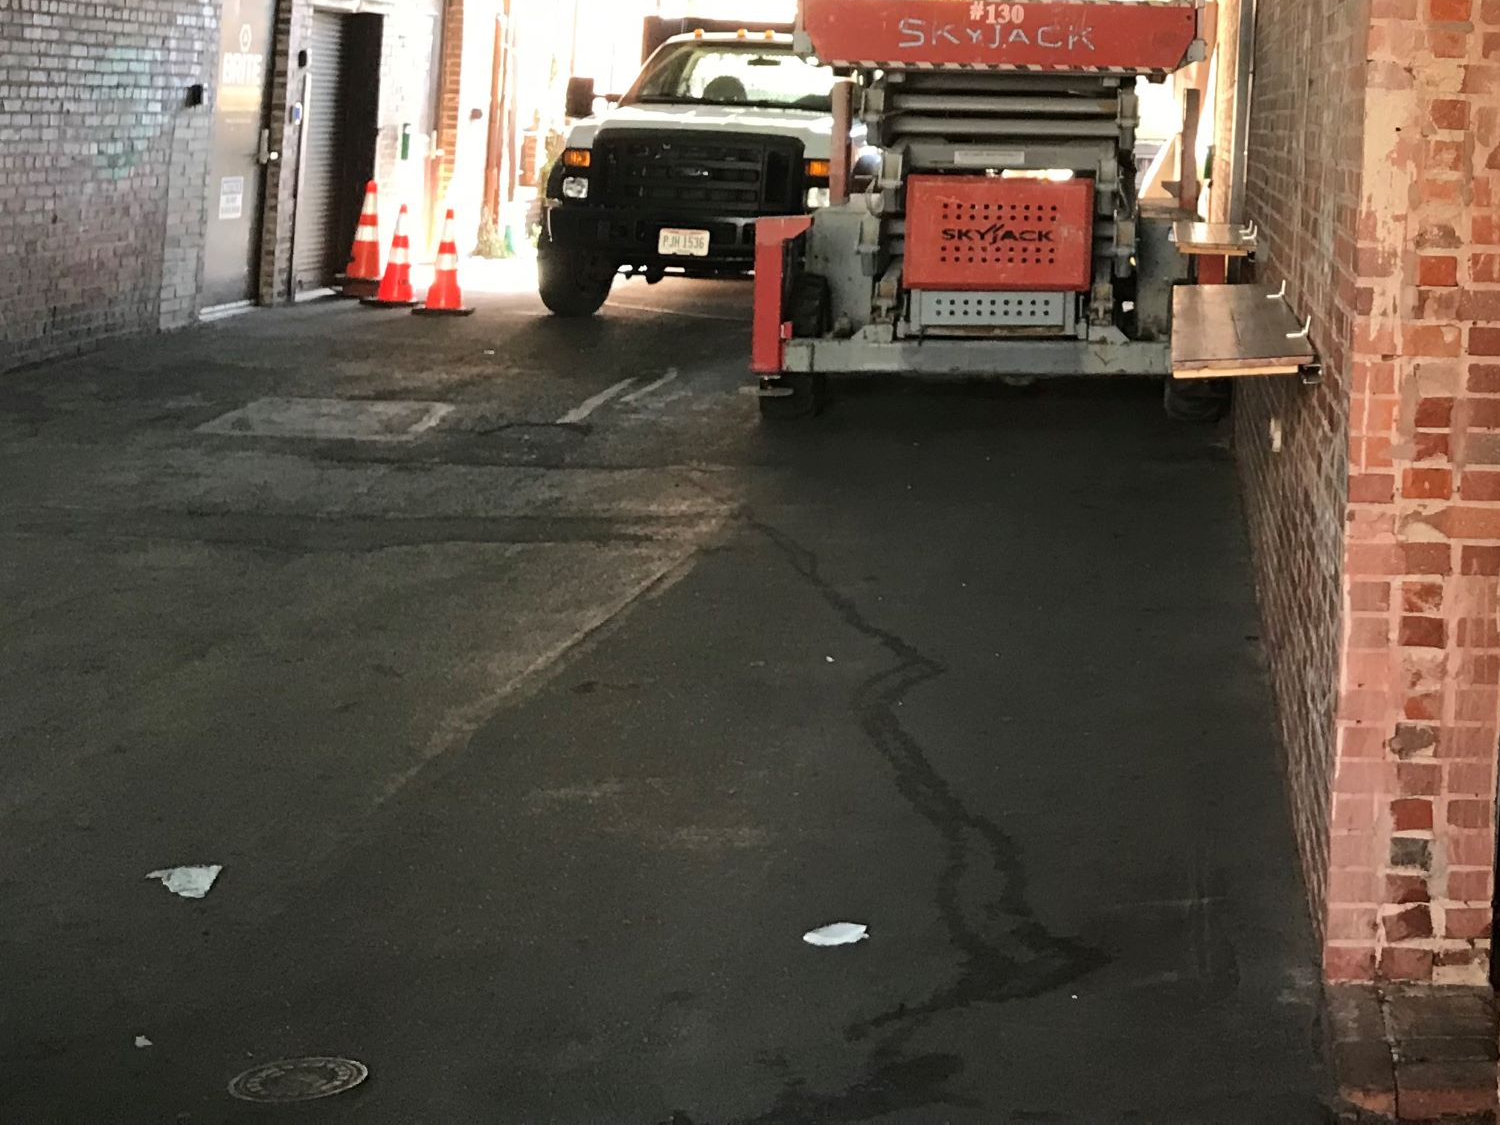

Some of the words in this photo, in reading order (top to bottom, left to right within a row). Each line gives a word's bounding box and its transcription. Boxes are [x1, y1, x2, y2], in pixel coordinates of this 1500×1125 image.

[969, 0, 1025, 24] #130
[898, 18, 1095, 51] SKYJACK
[683, 236, 705, 250] 1536
[941, 224, 1054, 246] SKYJACK
